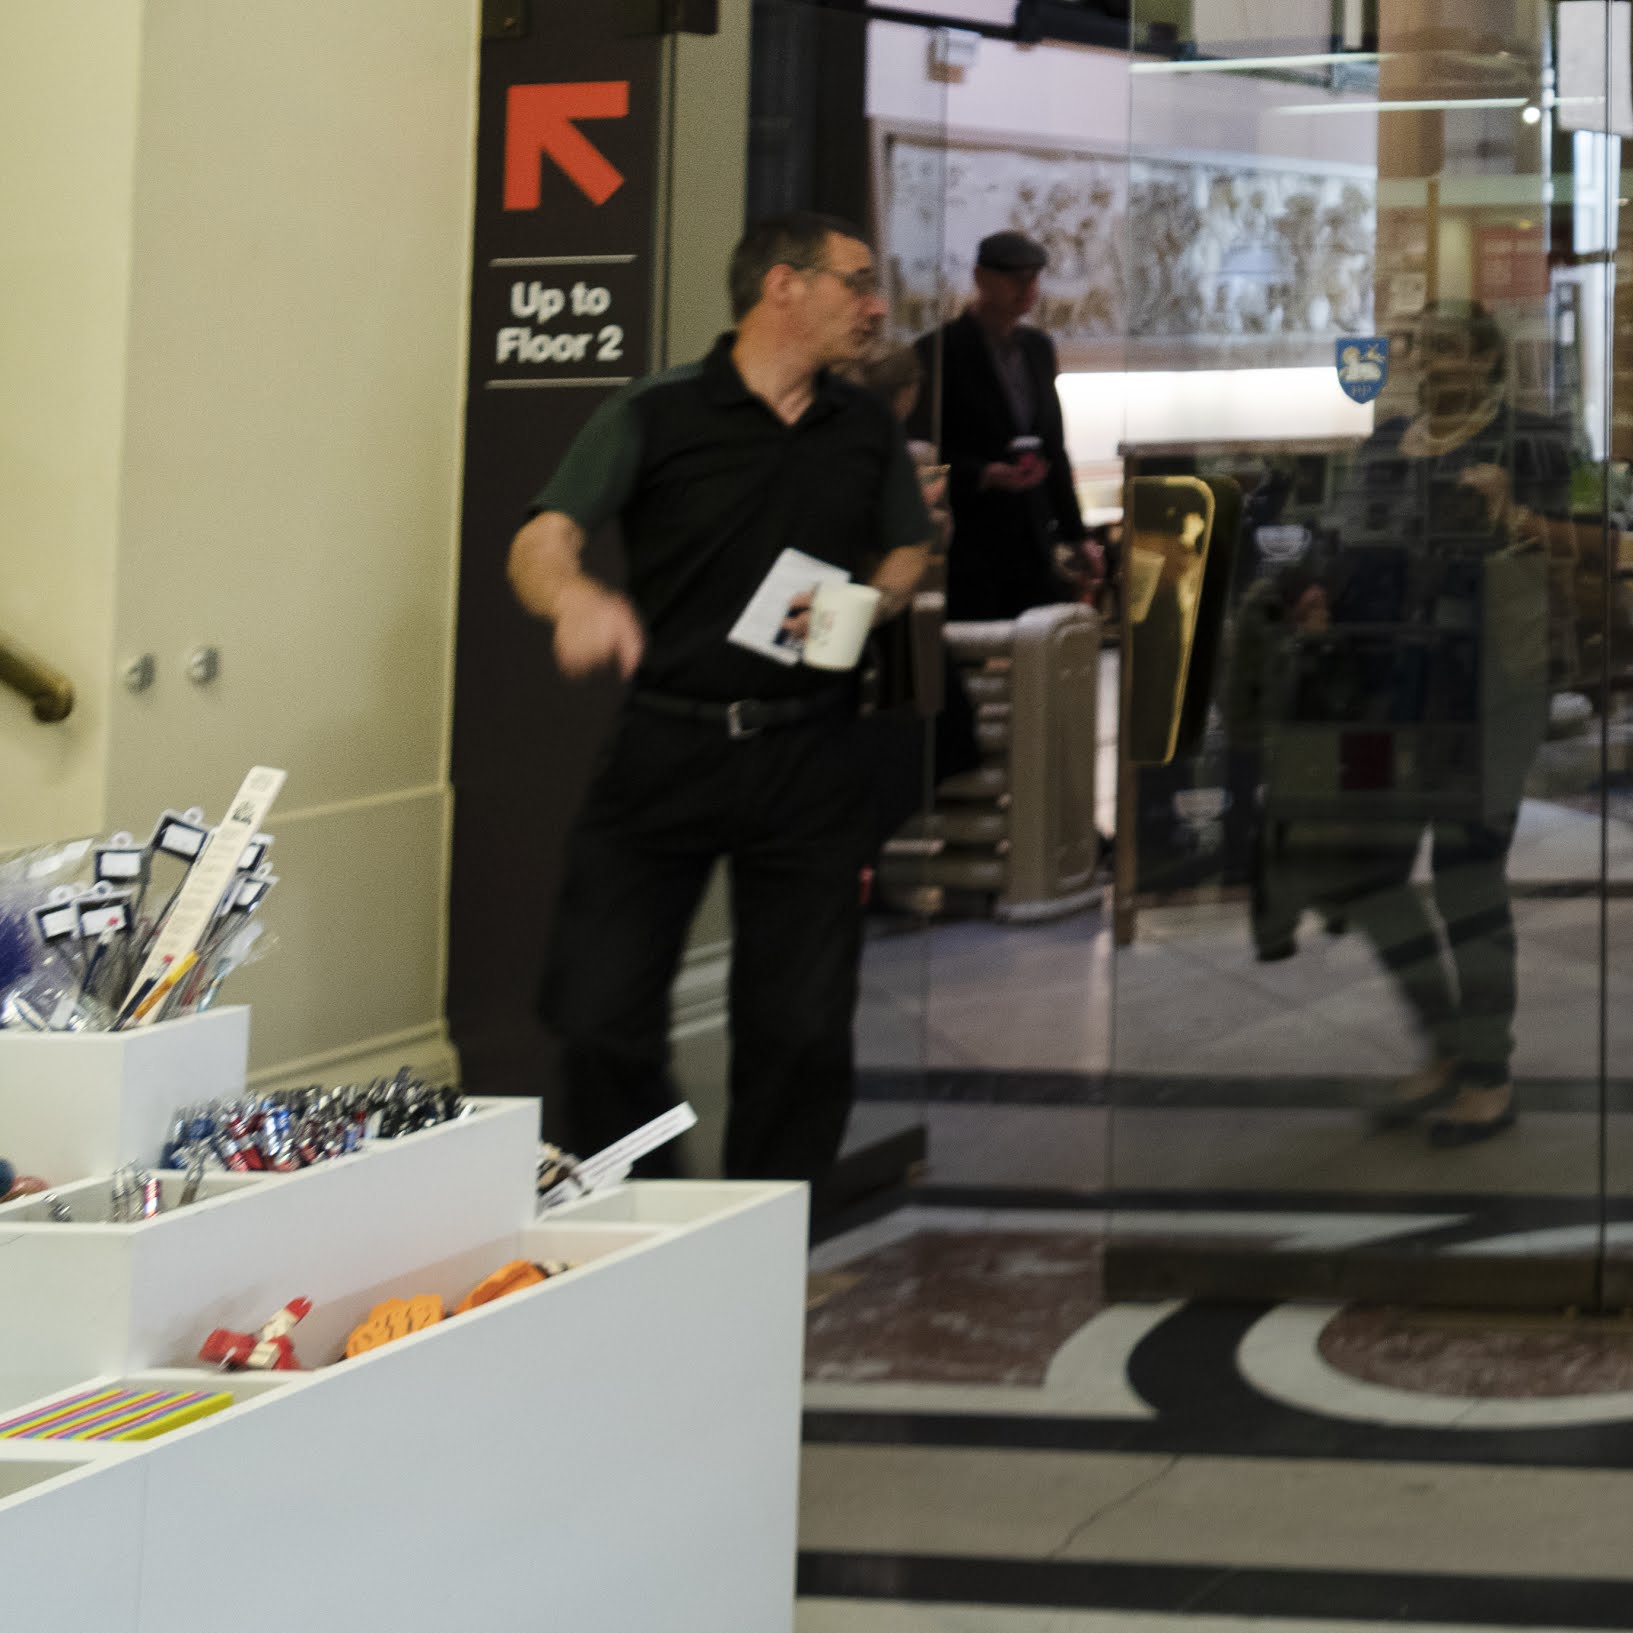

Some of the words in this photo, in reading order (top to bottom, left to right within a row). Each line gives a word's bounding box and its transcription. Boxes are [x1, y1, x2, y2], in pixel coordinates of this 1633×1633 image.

[511, 280, 564, 324] Up
[571, 280, 611, 315] to
[496, 326, 594, 364] Floor
[599, 324, 624, 361] 2
